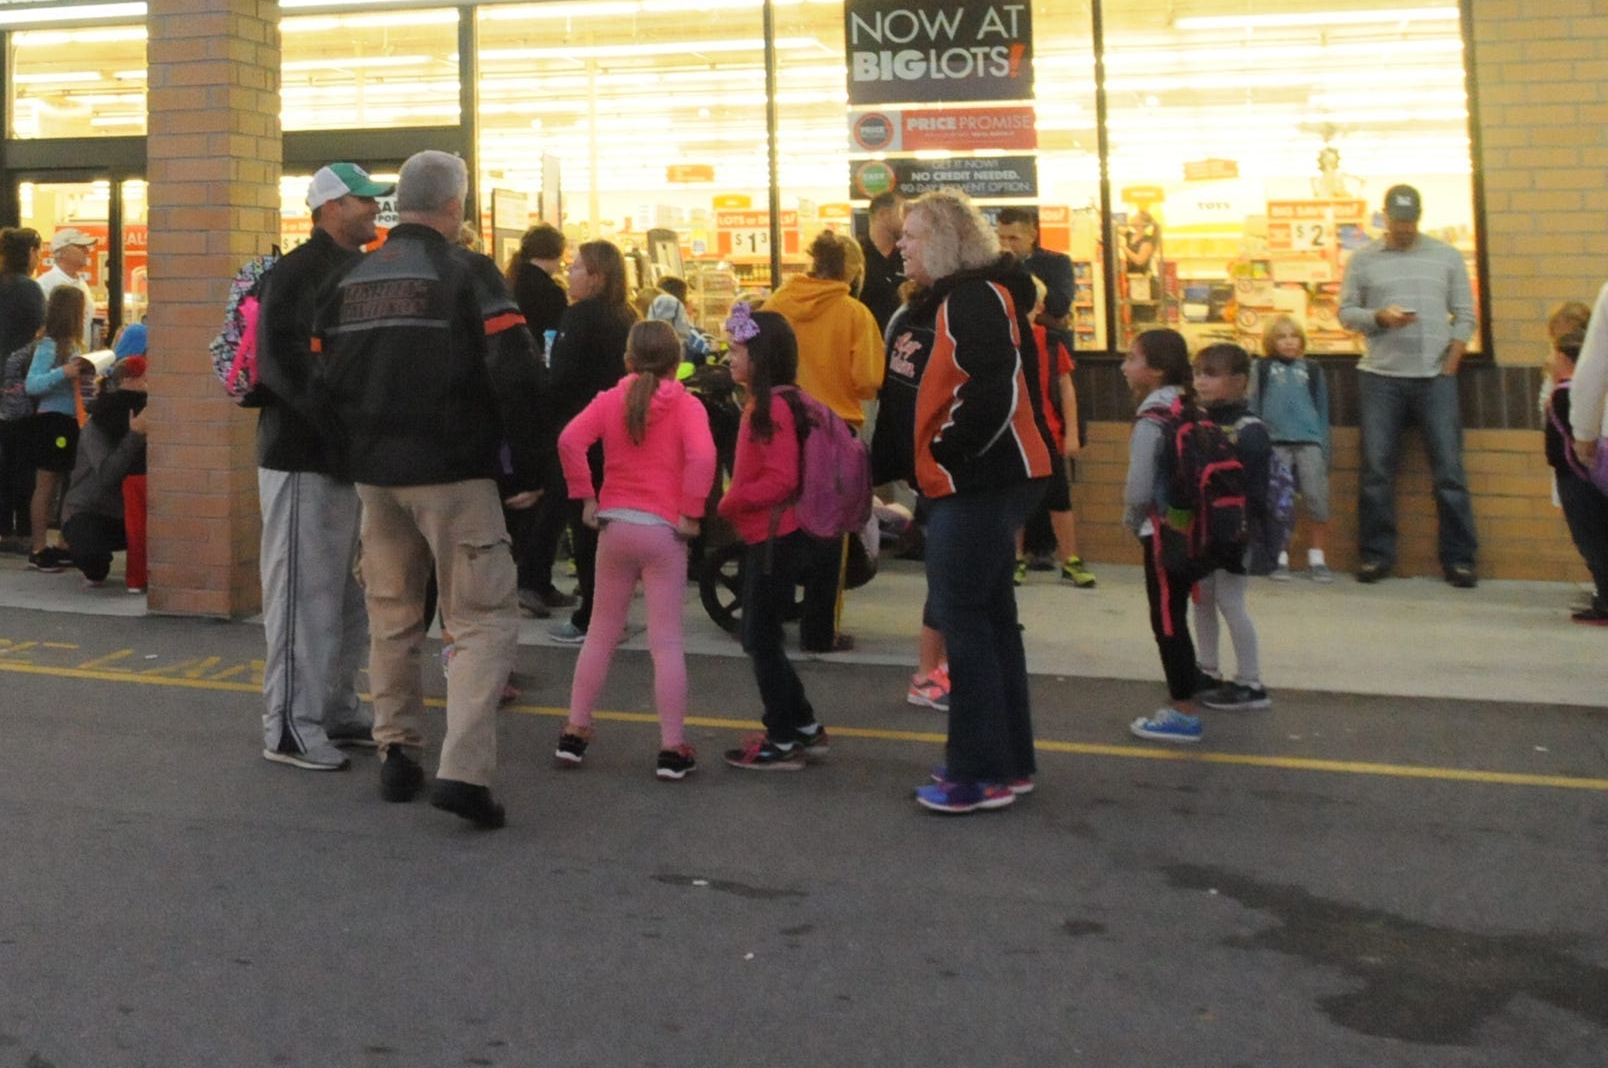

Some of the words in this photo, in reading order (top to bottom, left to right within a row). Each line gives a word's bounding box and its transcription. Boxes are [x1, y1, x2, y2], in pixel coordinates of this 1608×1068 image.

[850, 6, 966, 45] NOW
[975, 4, 1026, 41] AT
[906, 116, 957, 131] PRICE
[958, 114, 1032, 130] PROMISE
[911, 171, 931, 181] NO
[932, 171, 971, 181] CREDIT
[719, 214, 745, 225] LOTS
